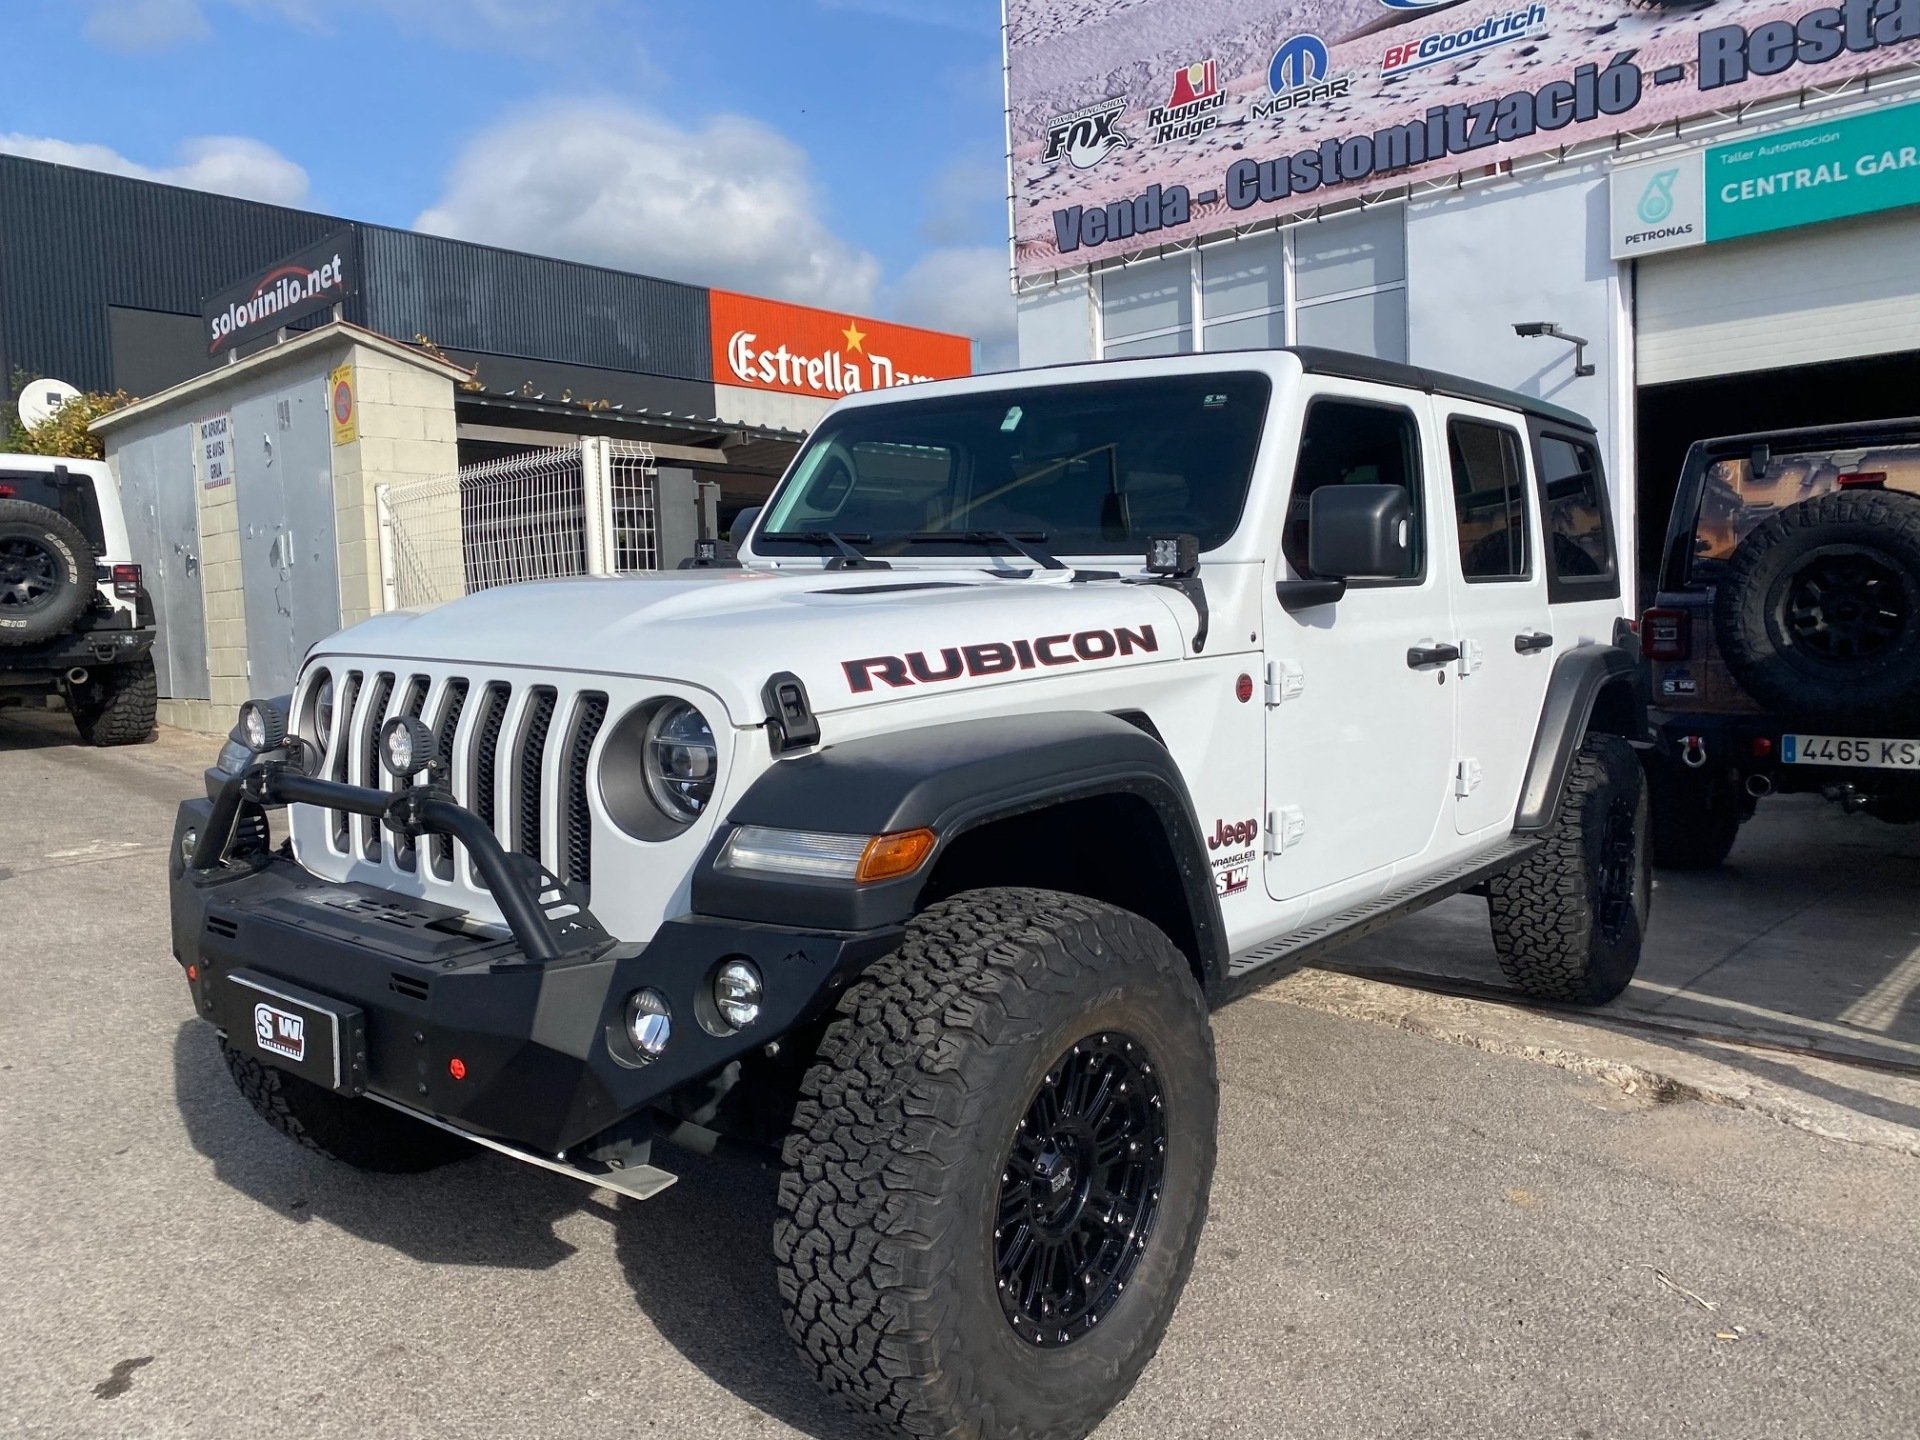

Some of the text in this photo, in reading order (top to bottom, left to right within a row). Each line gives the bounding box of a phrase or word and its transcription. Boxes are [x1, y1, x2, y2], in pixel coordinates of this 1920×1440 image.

[1382, 4, 1546, 70] BFGoodrich
[1148, 89, 1226, 127] Rugged
[1252, 78, 1349, 119] MOPAR
[1043, 107, 1124, 162] FOX
[1052, 184, 1190, 253] Venda
[1225, 48, 1642, 210] Customització
[1157, 116, 1216, 144] Ridge
[1720, 131, 1840, 165] Taller Automoción
[1720, 146, 1920, 203] CENTRAL GAR
[1625, 223, 1693, 245] PETRONAS
[211, 253, 342, 340] solovinilo.net
[727, 329, 862, 394] Estrella
[841, 624, 1158, 694] RUBICON
[1803, 739, 1920, 765] 4465 KS
[1208, 818, 1257, 850] Jeep
[1211, 850, 1256, 868] WRANGLER
